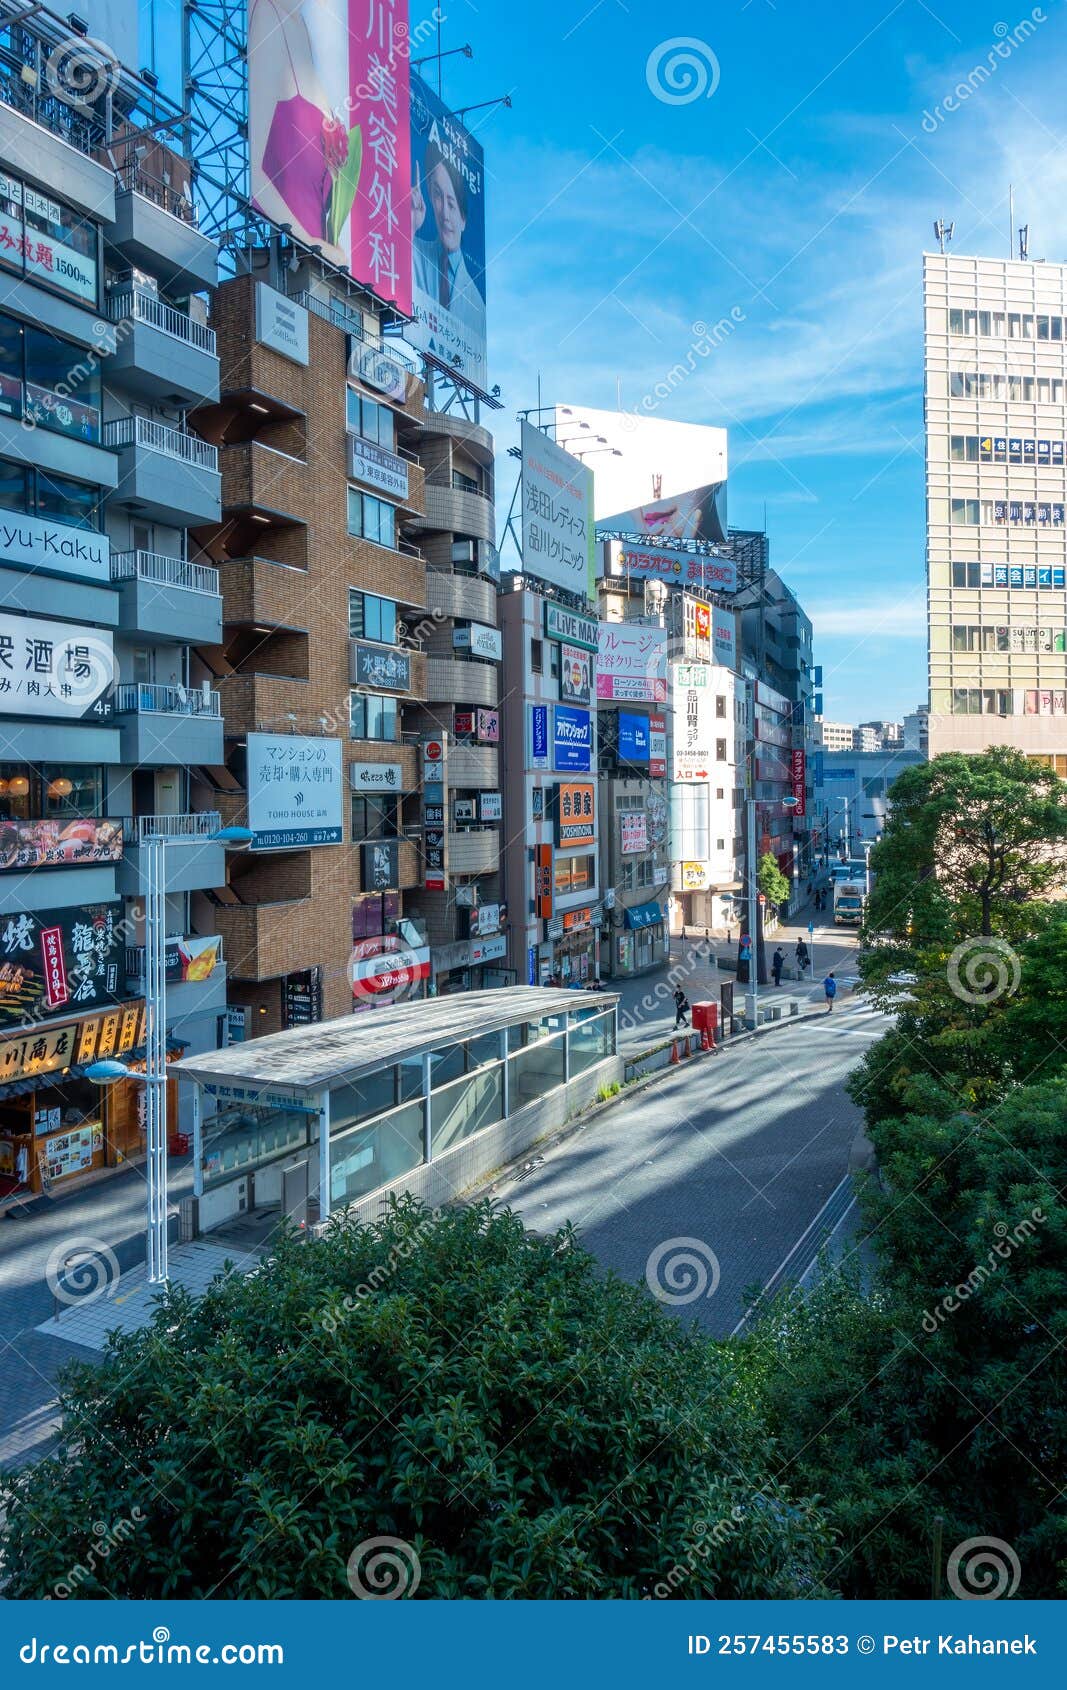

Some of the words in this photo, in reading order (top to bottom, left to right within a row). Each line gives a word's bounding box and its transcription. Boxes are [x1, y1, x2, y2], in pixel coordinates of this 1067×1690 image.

[428, 119, 480, 194] Asking!
[525, 479, 586, 540] 浅田レディース
[0, 524, 102, 564] yu-Kaku
[528, 522, 584, 571] 品川クリニック
[627, 551, 674, 573] カラオケ
[578, 621, 598, 646] MAX
[93, 700, 111, 716] 4F
[265, 746, 327, 762] マンションの
[676, 771, 693, 779] 入口
[268, 811, 289, 819] TOHO
[290, 810, 314, 819] HOUSE
[562, 791, 592, 817] 吉野家
